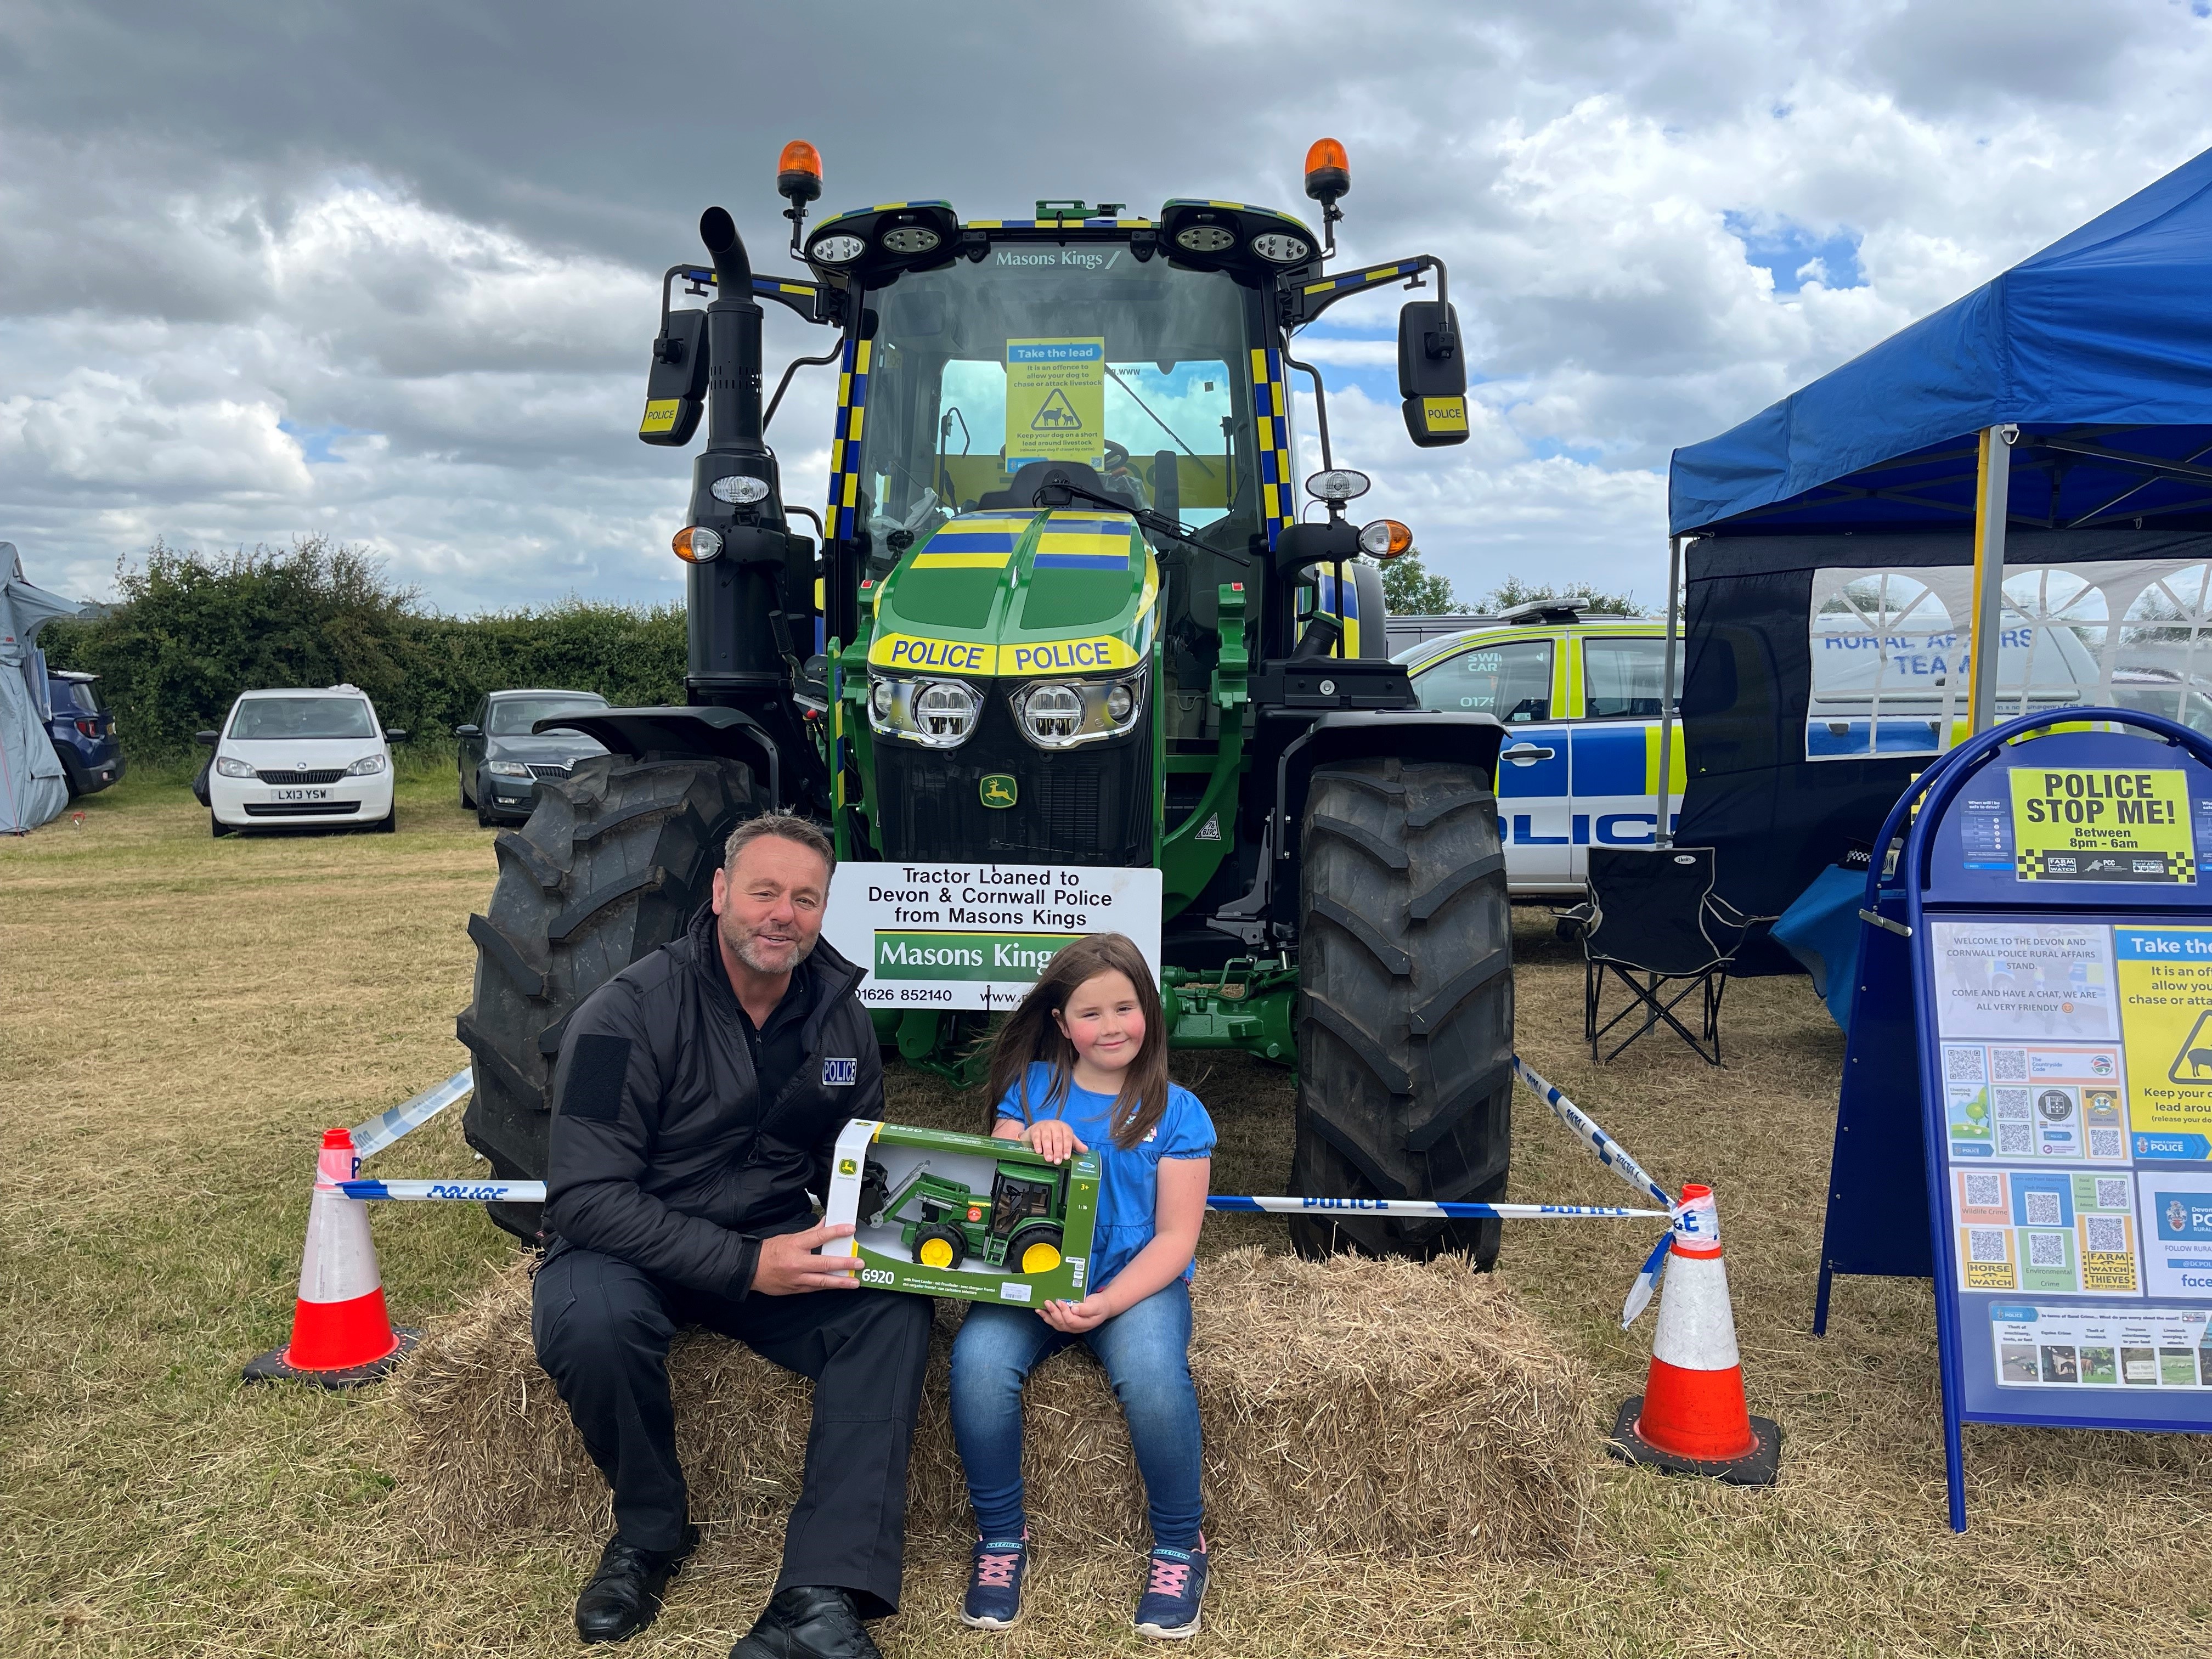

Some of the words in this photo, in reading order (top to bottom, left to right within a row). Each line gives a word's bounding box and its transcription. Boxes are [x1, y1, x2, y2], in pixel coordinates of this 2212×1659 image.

[996, 252, 1055, 266] Masons
[1062, 251, 1103, 269] Kings
[1018, 349, 1045, 358] Take
[1047, 348, 1066, 357] the
[1069, 347, 1093, 357] lead
[647, 410, 674, 420] POLICE
[1428, 409, 1462, 419] POLICE
[891, 640, 985, 669] POLICE
[1015, 642, 1111, 670] POLICE
[2045, 774, 2153, 798] POLICE
[279, 790, 302, 799] LX13
[306, 789, 326, 799] YSW
[2027, 799, 2104, 823] STOP
[2117, 800, 2175, 825] ME!
[2075, 827, 2131, 838] Between
[2069, 838, 2097, 849] 8pm
[2111, 839, 2138, 848] 6am
[903, 868, 970, 884] Tractor
[980, 868, 1051, 885] Loaned
[1061, 871, 1080, 886] to
[869, 887, 929, 903] Devon
[939, 888, 952, 904] &
[962, 888, 1045, 905] Cornwall
[1055, 890, 1112, 906] Police
[895, 907, 939, 923] from
[949, 907, 1024, 925] Masons
[1033, 909, 1086, 929] Kings
[2131, 938, 2181, 953] Take
[881, 941, 983, 967] Masons
[994, 943, 1058, 976] King
[2152, 966, 2161, 975] It
[2164, 966, 2175, 975] is
[2152, 980, 2187, 990] allow
[901, 989, 952, 1001] 852140
[2037, 991, 2061, 999] CHAT,
[2128, 994, 2166, 1004] chase
[825, 1061, 855, 1081] POLICE
[2144, 1088, 2175, 1099] Keep
[2177, 1090, 2204, 1099] your
[2155, 1102, 2180, 1111] lead
[861, 1268, 894, 1285] 6920
[2090, 1276, 2130, 1284] THIEVES
[1154, 1549, 1190, 1559] SKECHERS
